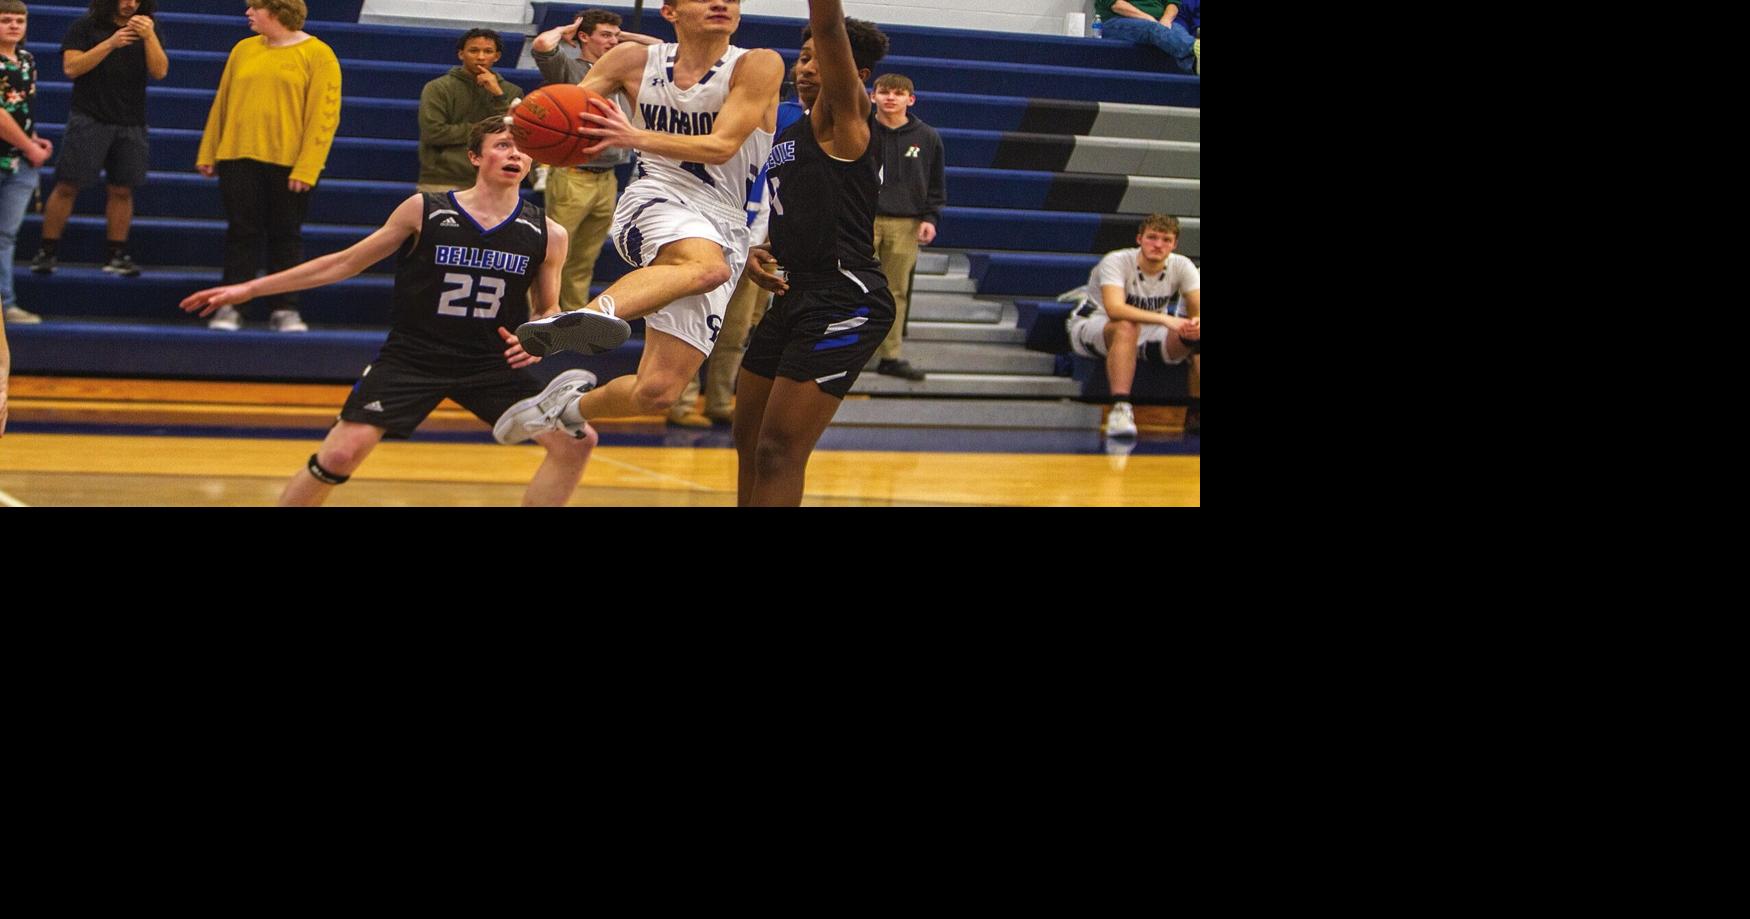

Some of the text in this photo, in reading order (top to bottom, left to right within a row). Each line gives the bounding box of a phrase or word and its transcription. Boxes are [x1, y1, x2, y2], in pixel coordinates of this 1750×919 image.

[765, 140, 796, 172] EVUE
[435, 244, 530, 275] BELLEVUE
[437, 272, 506, 318] 23
